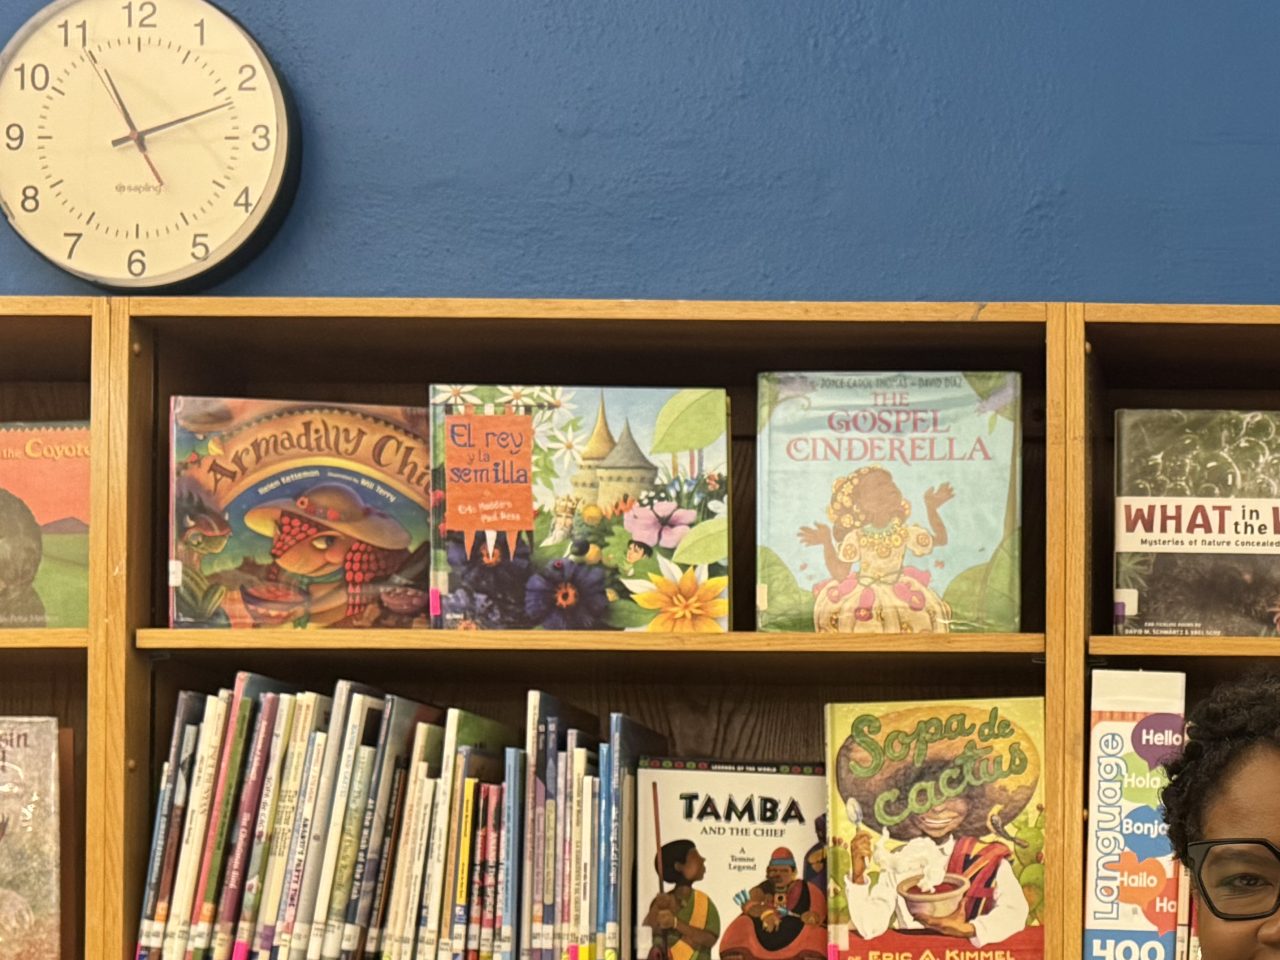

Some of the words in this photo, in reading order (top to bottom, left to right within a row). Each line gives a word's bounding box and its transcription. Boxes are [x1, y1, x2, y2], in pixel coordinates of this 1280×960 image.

[122, 2, 157, 28] 12
[58, 20, 87, 48] 11
[194, 19, 205, 46] 1
[14, 63, 50, 91] 10
[237, 64, 257, 91] 2
[5, 123, 25, 151] 9
[251, 124, 271, 151] 3
[21, 186, 39, 213] 8
[233, 187, 253, 213] 4
[63, 233, 83, 259] 7
[190, 234, 209, 261] 5
[127, 250, 146, 277] 6
[872, 391, 910, 407] THE
[827, 408, 951, 434] GOSPEL
[451, 424, 474, 448] El
[485, 431, 523, 455] rey
[786, 436, 992, 466] CINDERELLA
[207, 419, 367, 494] Armadilly
[372, 434, 430, 494] Chi
[478, 450, 490, 462] la
[450, 460, 528, 485] semilla
[1123, 504, 1232, 535] WHAT
[1241, 505, 1260, 520] in
[1233, 521, 1268, 535] the
[1140, 537, 1185, 548] Mysteries
[1188, 538, 1198, 547] of
[1235, 539, 1280, 548] Concealed
[849, 711, 976, 779] Sopa
[978, 706, 1015, 742] de
[1141, 728, 1183, 747] Hello
[874, 741, 1029, 826] cactus
[1123, 773, 1161, 789] Hola
[679, 792, 805, 825] TAMBA
[700, 826, 726, 836] AND
[729, 827, 751, 837] THE
[753, 827, 786, 838] CHIEF
[1093, 732, 1127, 921] Language
[1121, 818, 1170, 837] Bonjo
[728, 863, 757, 872] Legend
